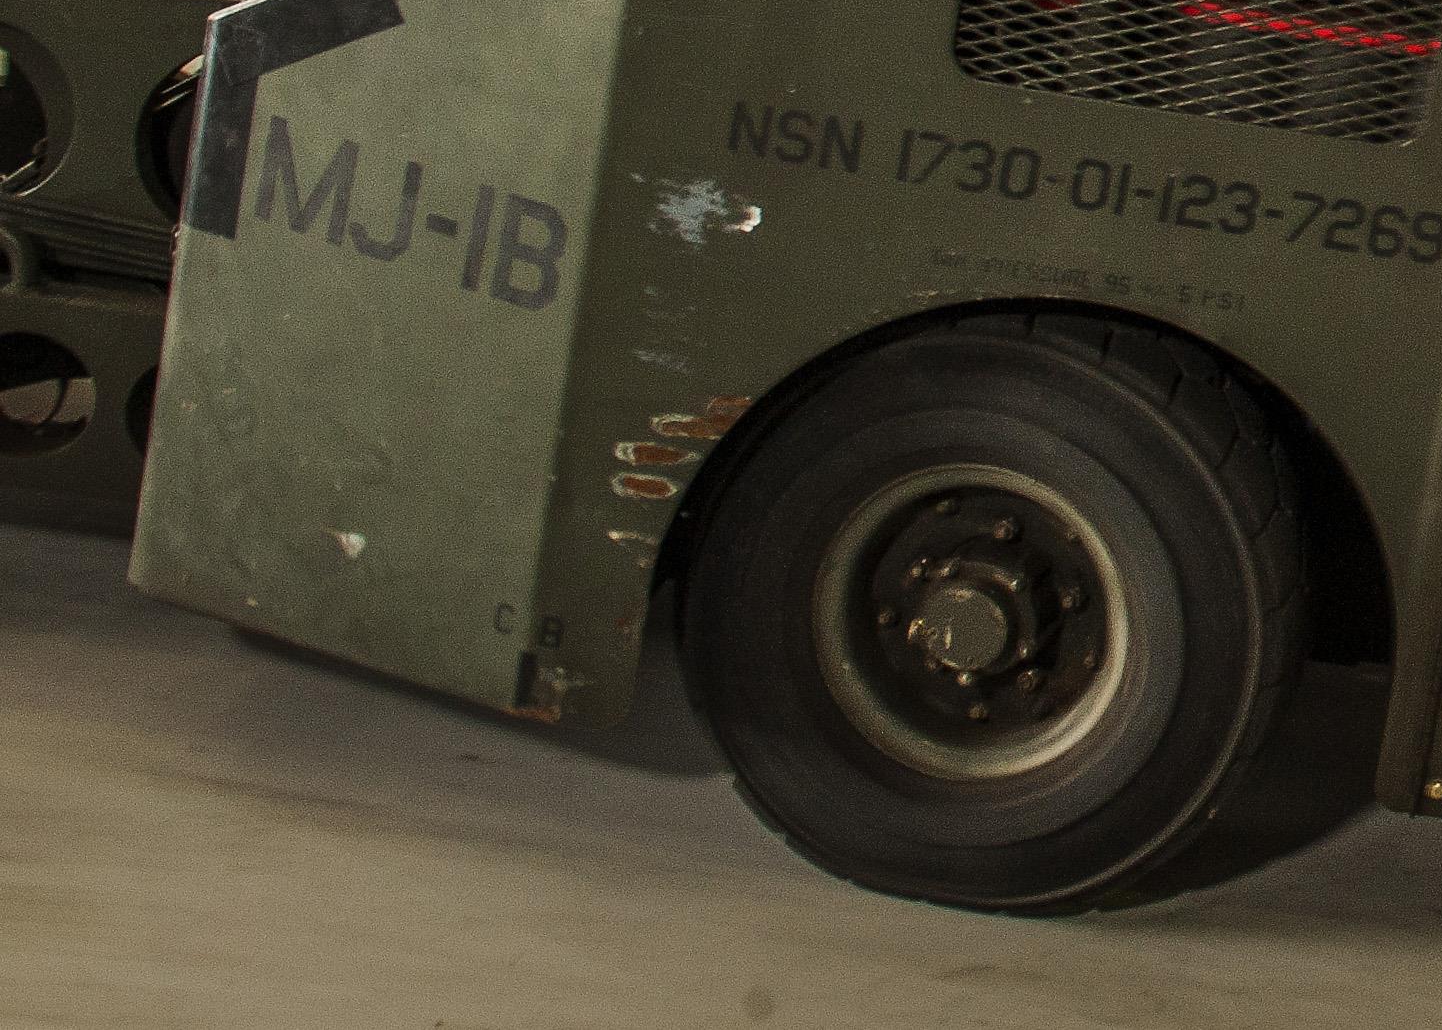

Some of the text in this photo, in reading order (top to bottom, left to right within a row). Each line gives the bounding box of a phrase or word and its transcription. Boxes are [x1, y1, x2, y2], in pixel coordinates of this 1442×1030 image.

[727, 101, 863, 174] NSN
[1103, 272, 1131, 295] 95
[1177, 284, 1194, 303] 5
[494, 602, 565, 649] C B
